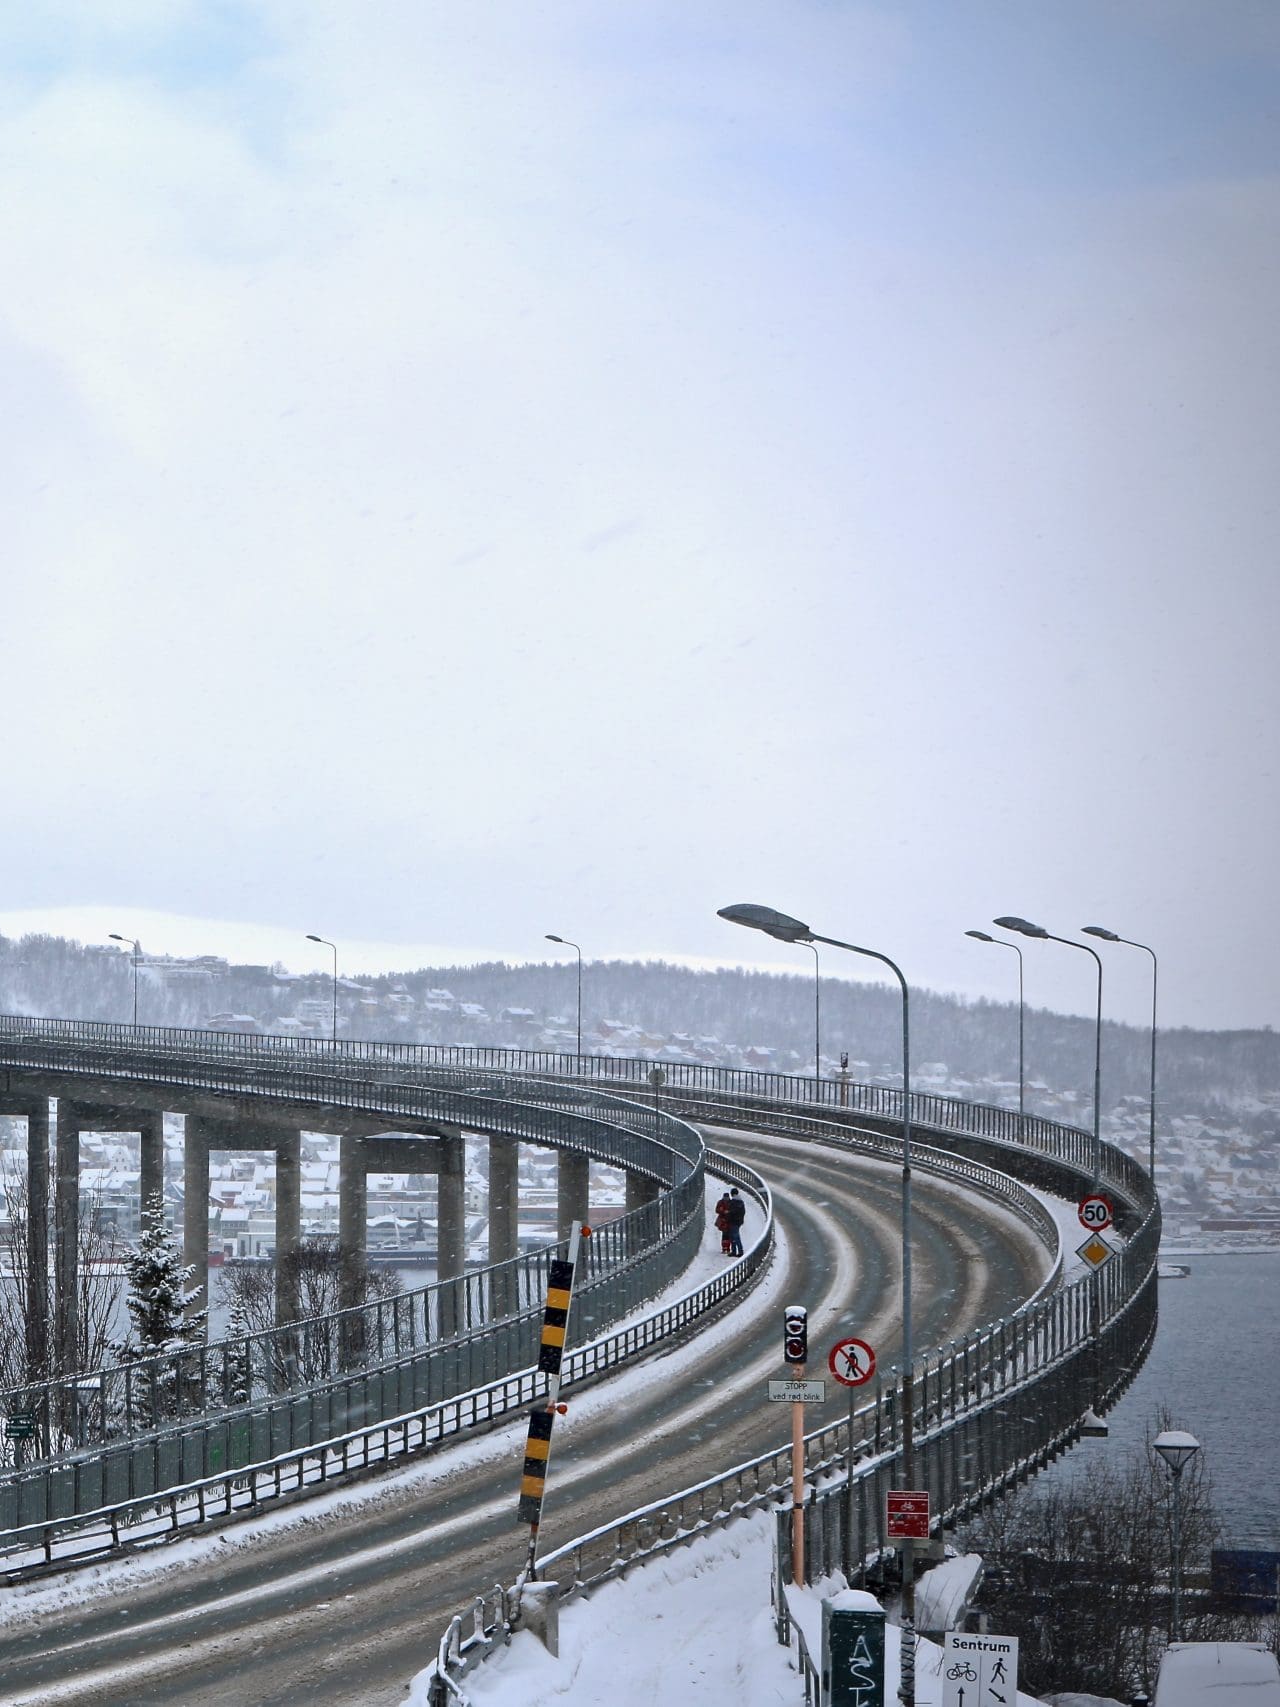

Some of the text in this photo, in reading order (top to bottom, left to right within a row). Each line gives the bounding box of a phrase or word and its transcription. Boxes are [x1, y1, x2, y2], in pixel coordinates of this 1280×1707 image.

[1084, 1204, 1107, 1222] 50
[784, 1382, 808, 1390] STOPP
[952, 1638, 1010, 1653] Sentrum
